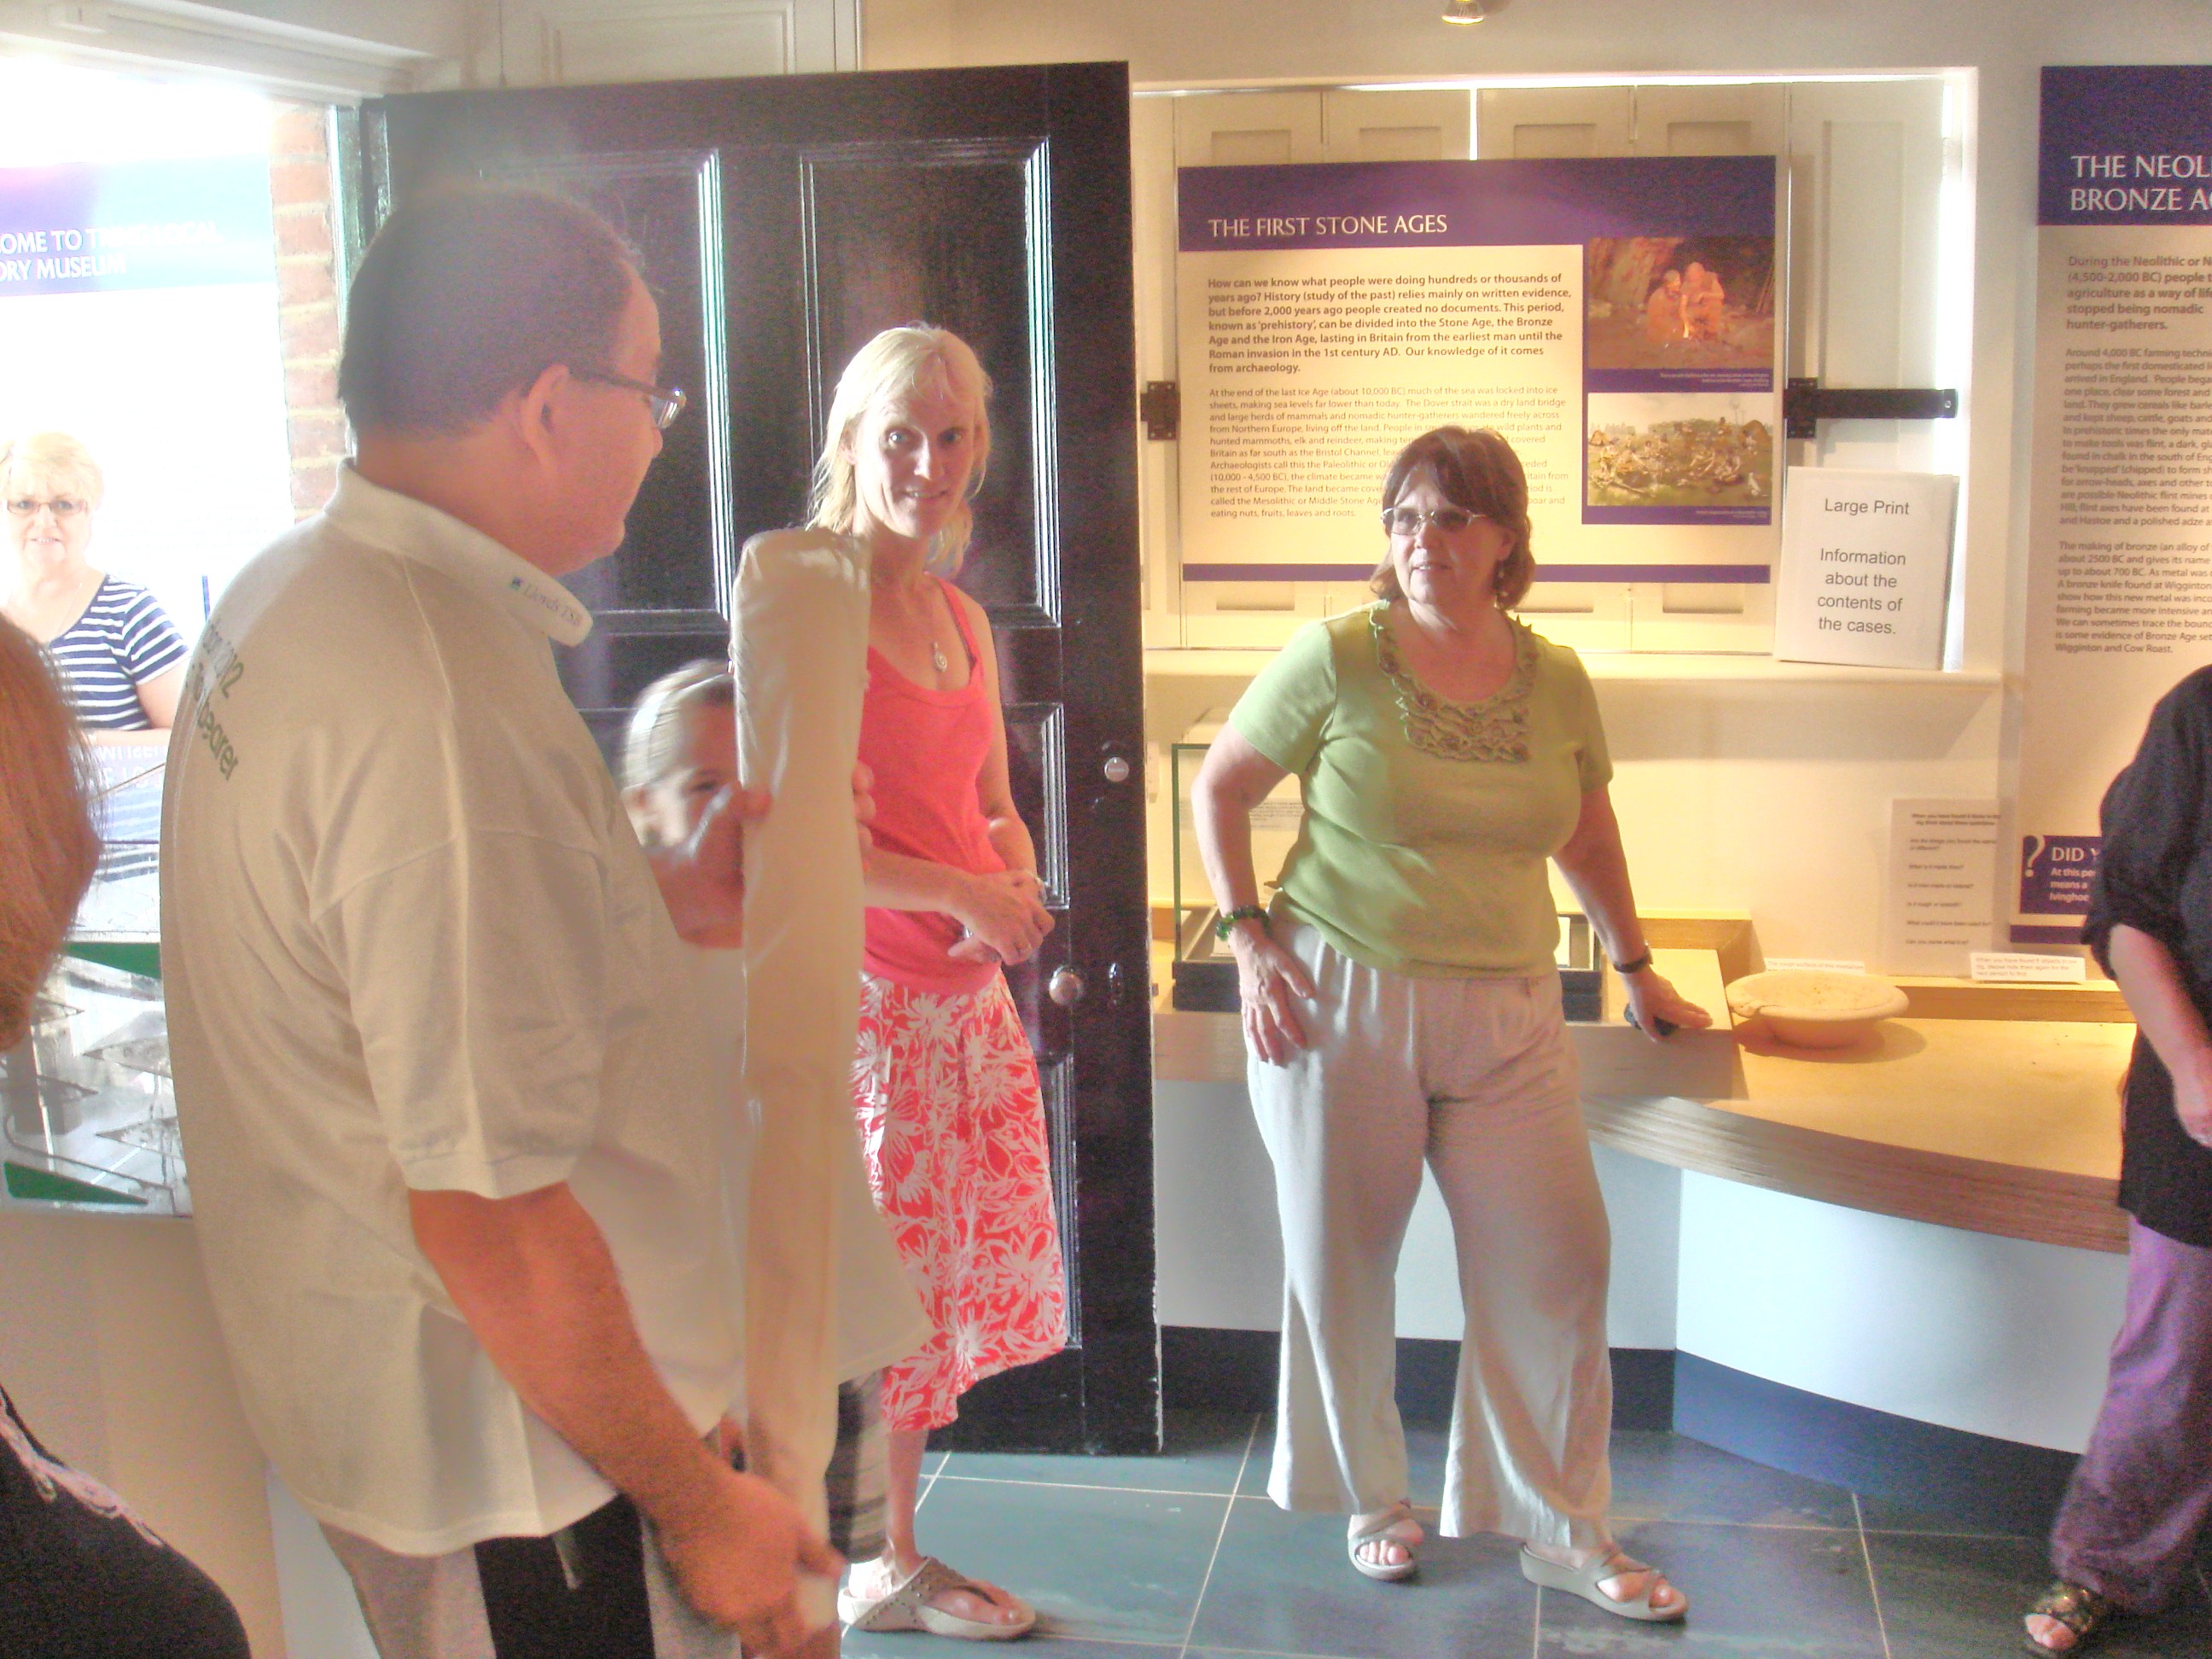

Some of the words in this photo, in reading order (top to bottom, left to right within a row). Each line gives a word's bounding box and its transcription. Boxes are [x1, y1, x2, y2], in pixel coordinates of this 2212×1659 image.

[2071, 155, 2126, 178] THE
[2135, 155, 2212, 178] NEOL
[2071, 189, 2183, 210] BRONZE
[2190, 188, 2212, 210] A
[1210, 219, 1249, 237] THE
[1257, 218, 1308, 236] FIRST
[1316, 217, 1388, 235] STONE
[1394, 216, 1447, 233] AGES
[0, 231, 48, 254] OME
[51, 230, 83, 251] TO
[37, 253, 126, 279] MUSEUM
[2069, 257, 2107, 268] During
[2112, 257, 2130, 266] the
[2134, 257, 2185, 266] Neolithic
[1208, 277, 1231, 288] How
[1271, 276, 1299, 287] know
[1301, 276, 1326, 287] what
[1330, 276, 1365, 288] people
[1395, 275, 1425, 288] doing
[1428, 274, 1477, 285] hundreds
[1494, 273, 1548, 284] thousands
[1551, 273, 1561, 283] of
[2143, 272, 2161, 282] BC)
[2165, 272, 2204, 284] people
[1208, 294, 1235, 305] years
[1237, 291, 1260, 305] ago?
[1264, 291, 1301, 304] History
[1303, 290, 1335, 304] (study
[1337, 290, 1348, 300] of
[1351, 290, 1367, 300] the
[1370, 289, 1395, 302] past)
[1398, 289, 1425, 300] relies
[1429, 288, 1463, 301] mainly
[1481, 288, 1519, 298] written
[1522, 287, 1571, 300] evidence,
[2068, 288, 2131, 300] agriculture
[2158, 291, 2181, 300] way
[2185, 288, 2195, 298] of
[1208, 306, 1225, 316] but
[1229, 306, 1261, 316] before
[1265, 305, 1292, 317] 2,000
[1294, 307, 1321, 317] years
[1324, 307, 1342, 317] ago
[1345, 304, 1381, 317] people
[1383, 303, 1422, 313] created
[1441, 302, 1501, 313] documents.
[1505, 302, 1524, 312] This
[1528, 301, 1563, 315] period,
[2067, 304, 2114, 315] stopped
[2118, 304, 2151, 315] being
[2154, 304, 2203, 313] nomadic
[1208, 320, 1243, 330] known
[1340, 318, 1352, 329] be
[1355, 317, 1394, 328] divided
[1396, 317, 1417, 328] into
[1419, 317, 1436, 327] the
[1439, 317, 1469, 327] Stone
[1472, 317, 1493, 329] Age,
[1497, 316, 1514, 326] the
[1516, 316, 1552, 326] Bronze
[2067, 320, 2168, 331] hunter-gatherers.
[1209, 334, 1228, 346] Age
[1231, 334, 1250, 344] and
[1253, 334, 1269, 343] the
[1272, 333, 1292, 343] Iron
[1295, 333, 1317, 346] Age,
[1320, 333, 1354, 346] lasting
[1357, 332, 1366, 342] in
[1370, 332, 1403, 342] Britain
[1406, 332, 1430, 341] from
[1434, 331, 1450, 341] the
[1452, 331, 1490, 341] earliest
[1519, 330, 1542, 341] until
[1545, 330, 1563, 341] the
[1209, 347, 1244, 358] Roman
[1247, 347, 1289, 358] invasion
[1292, 347, 1301, 357] in
[1304, 346, 1321, 357] the
[1325, 346, 1338, 357] 1st
[1342, 346, 1380, 359] century
[1383, 346, 1400, 356] AD.
[1406, 346, 1424, 356] Our
[1428, 346, 1485, 358] knowledge
[1487, 346, 1498, 355] of
[1501, 345, 1507, 355] it
[1209, 363, 1233, 372] from
[1236, 362, 1301, 375] archaeology.
[1825, 498, 1868, 515] Large
[1874, 500, 1909, 515] Print
[1820, 549, 1906, 565] Information
[1825, 573, 1868, 586] about
[1873, 575, 1897, 587] the
[1818, 597, 1882, 609] contents
[1888, 598, 1903, 611] of
[1819, 617, 1842, 630] the
[1848, 620, 1895, 634] cases.
[2052, 847, 2084, 861] DID
[2064, 868, 2080, 876] this
